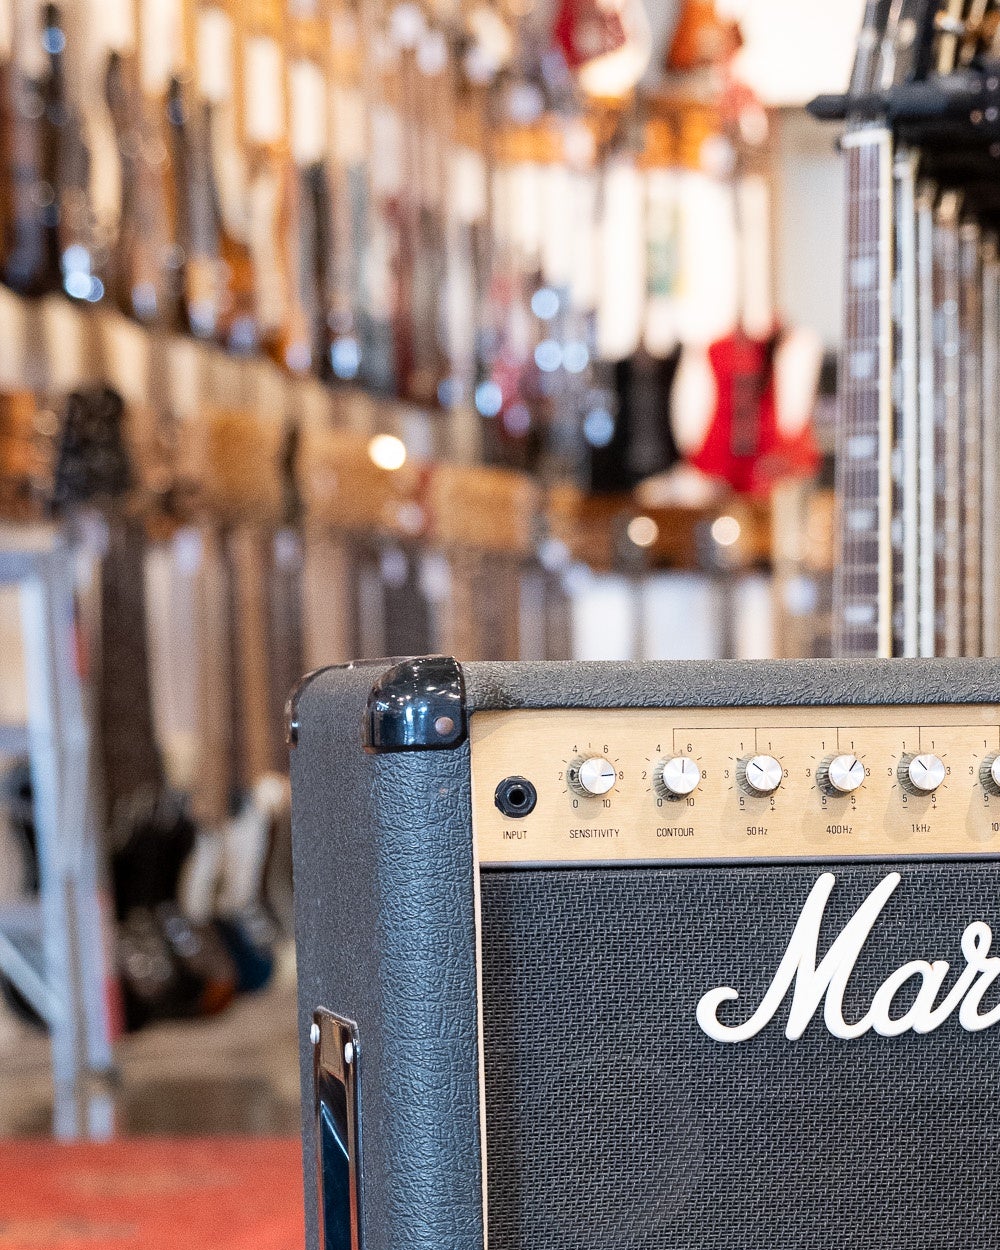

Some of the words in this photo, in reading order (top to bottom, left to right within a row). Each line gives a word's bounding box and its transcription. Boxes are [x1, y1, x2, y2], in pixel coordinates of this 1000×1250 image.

[572, 744, 578, 753] 4
[603, 744, 609, 754] 6
[655, 744, 661, 753] 4
[686, 743, 693, 753] 6
[618, 770, 624, 780] 8
[641, 770, 647, 780] 2
[701, 769, 707, 779] 8
[724, 769, 730, 779] 3
[783, 768, 789, 778] 3
[805, 768, 811, 778] 3
[865, 767, 871, 777] 3
[887, 767, 893, 777] 3
[946, 766, 952, 776] 3
[968, 765, 974, 775] 3
[558, 771, 563, 781] 2
[686, 797, 695, 807] 10
[739, 796, 745, 806] 5
[770, 796, 775, 806] 5
[821, 795, 827, 805] 5
[851, 795, 856, 804] 5
[902, 794, 908, 803] 5
[931, 793, 937, 803] 5
[983, 792, 989, 802] 5
[572, 799, 579, 809] 0
[602, 798, 611, 808] 10
[656, 797, 663, 808] 0
[656, 827, 695, 838] CONTOUR
[825, 824, 853, 835] 400Hz
[911, 823, 931, 833] 1kHz
[502, 830, 528, 840] INPUT
[569, 828, 620, 839] SENSITIVITY
